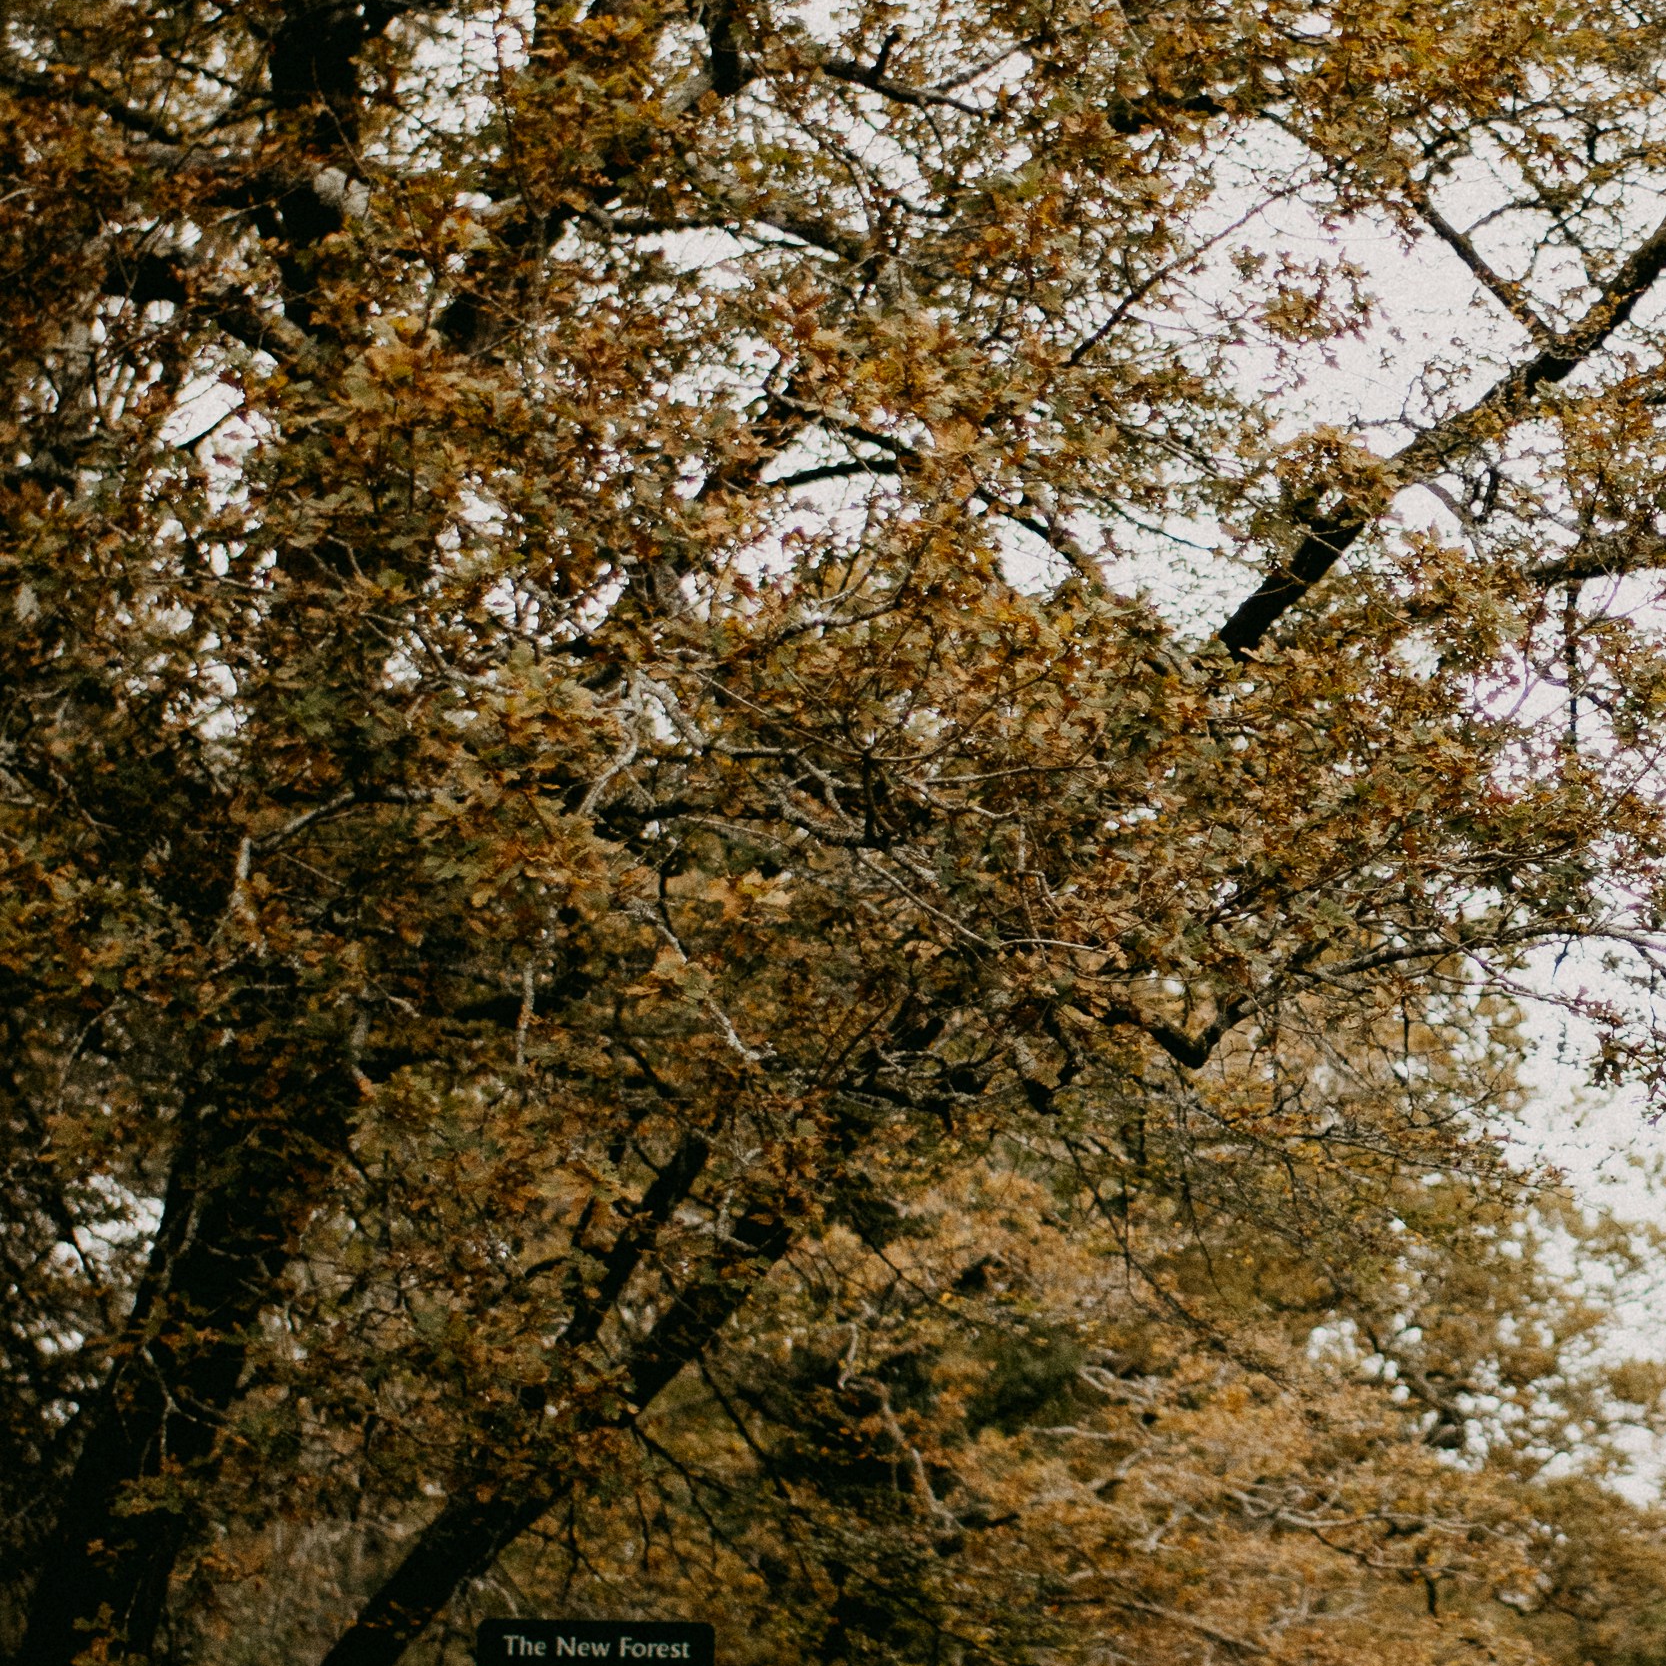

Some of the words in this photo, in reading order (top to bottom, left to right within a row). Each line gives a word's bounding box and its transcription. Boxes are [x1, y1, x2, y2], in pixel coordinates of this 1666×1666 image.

[503, 1634, 546, 1657] The
[556, 1636, 610, 1658] New
[619, 1637, 690, 1659] Forest
